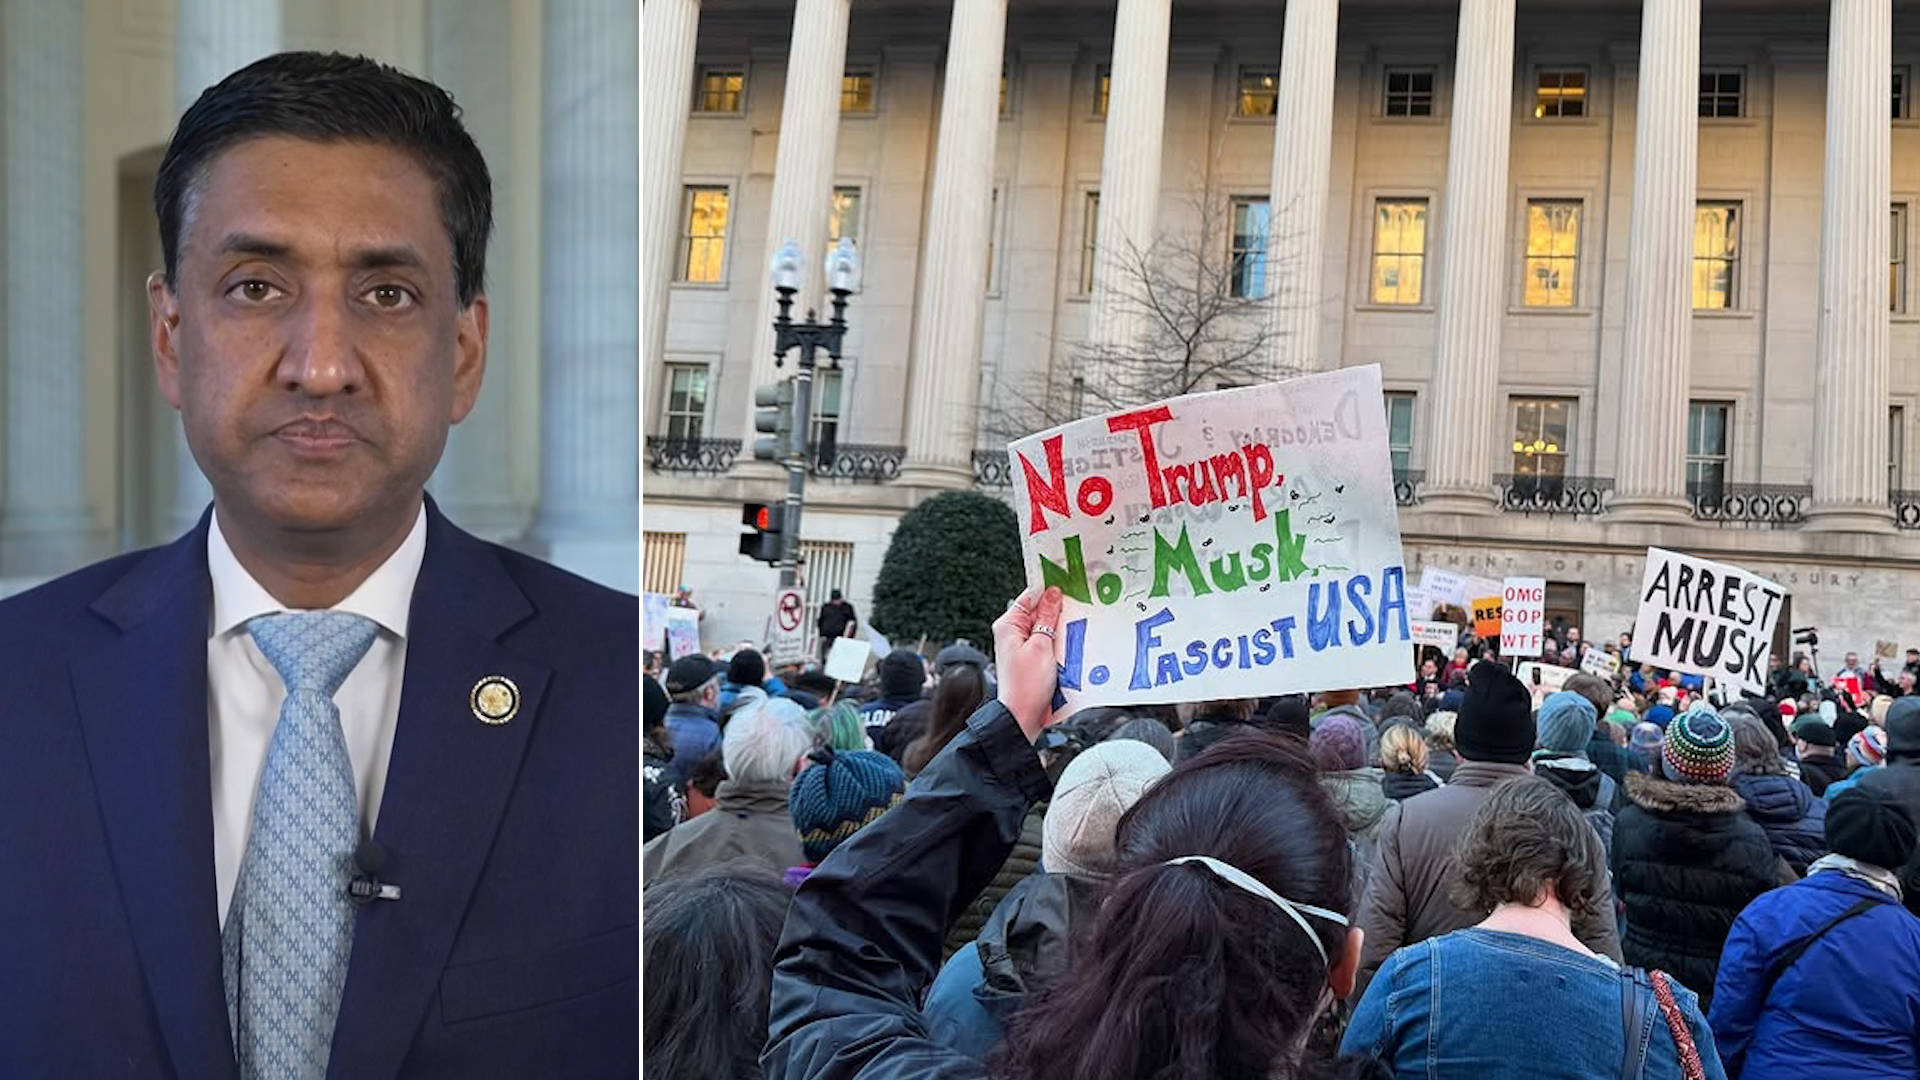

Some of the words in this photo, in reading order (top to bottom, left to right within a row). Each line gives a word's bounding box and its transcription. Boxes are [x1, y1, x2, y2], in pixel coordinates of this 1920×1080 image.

[1016, 434, 1113, 536] No
[1107, 405, 1286, 523] Trump,
[1149, 508, 1320, 598] Musk,
[1308, 566, 1411, 652] USA
[1502, 608, 1542, 625] GOP
[1505, 586, 1543, 603] OMG
[1644, 560, 1781, 632] ARREST
[1501, 634, 1541, 650] WTF
[1651, 611, 1768, 686] MUSK
